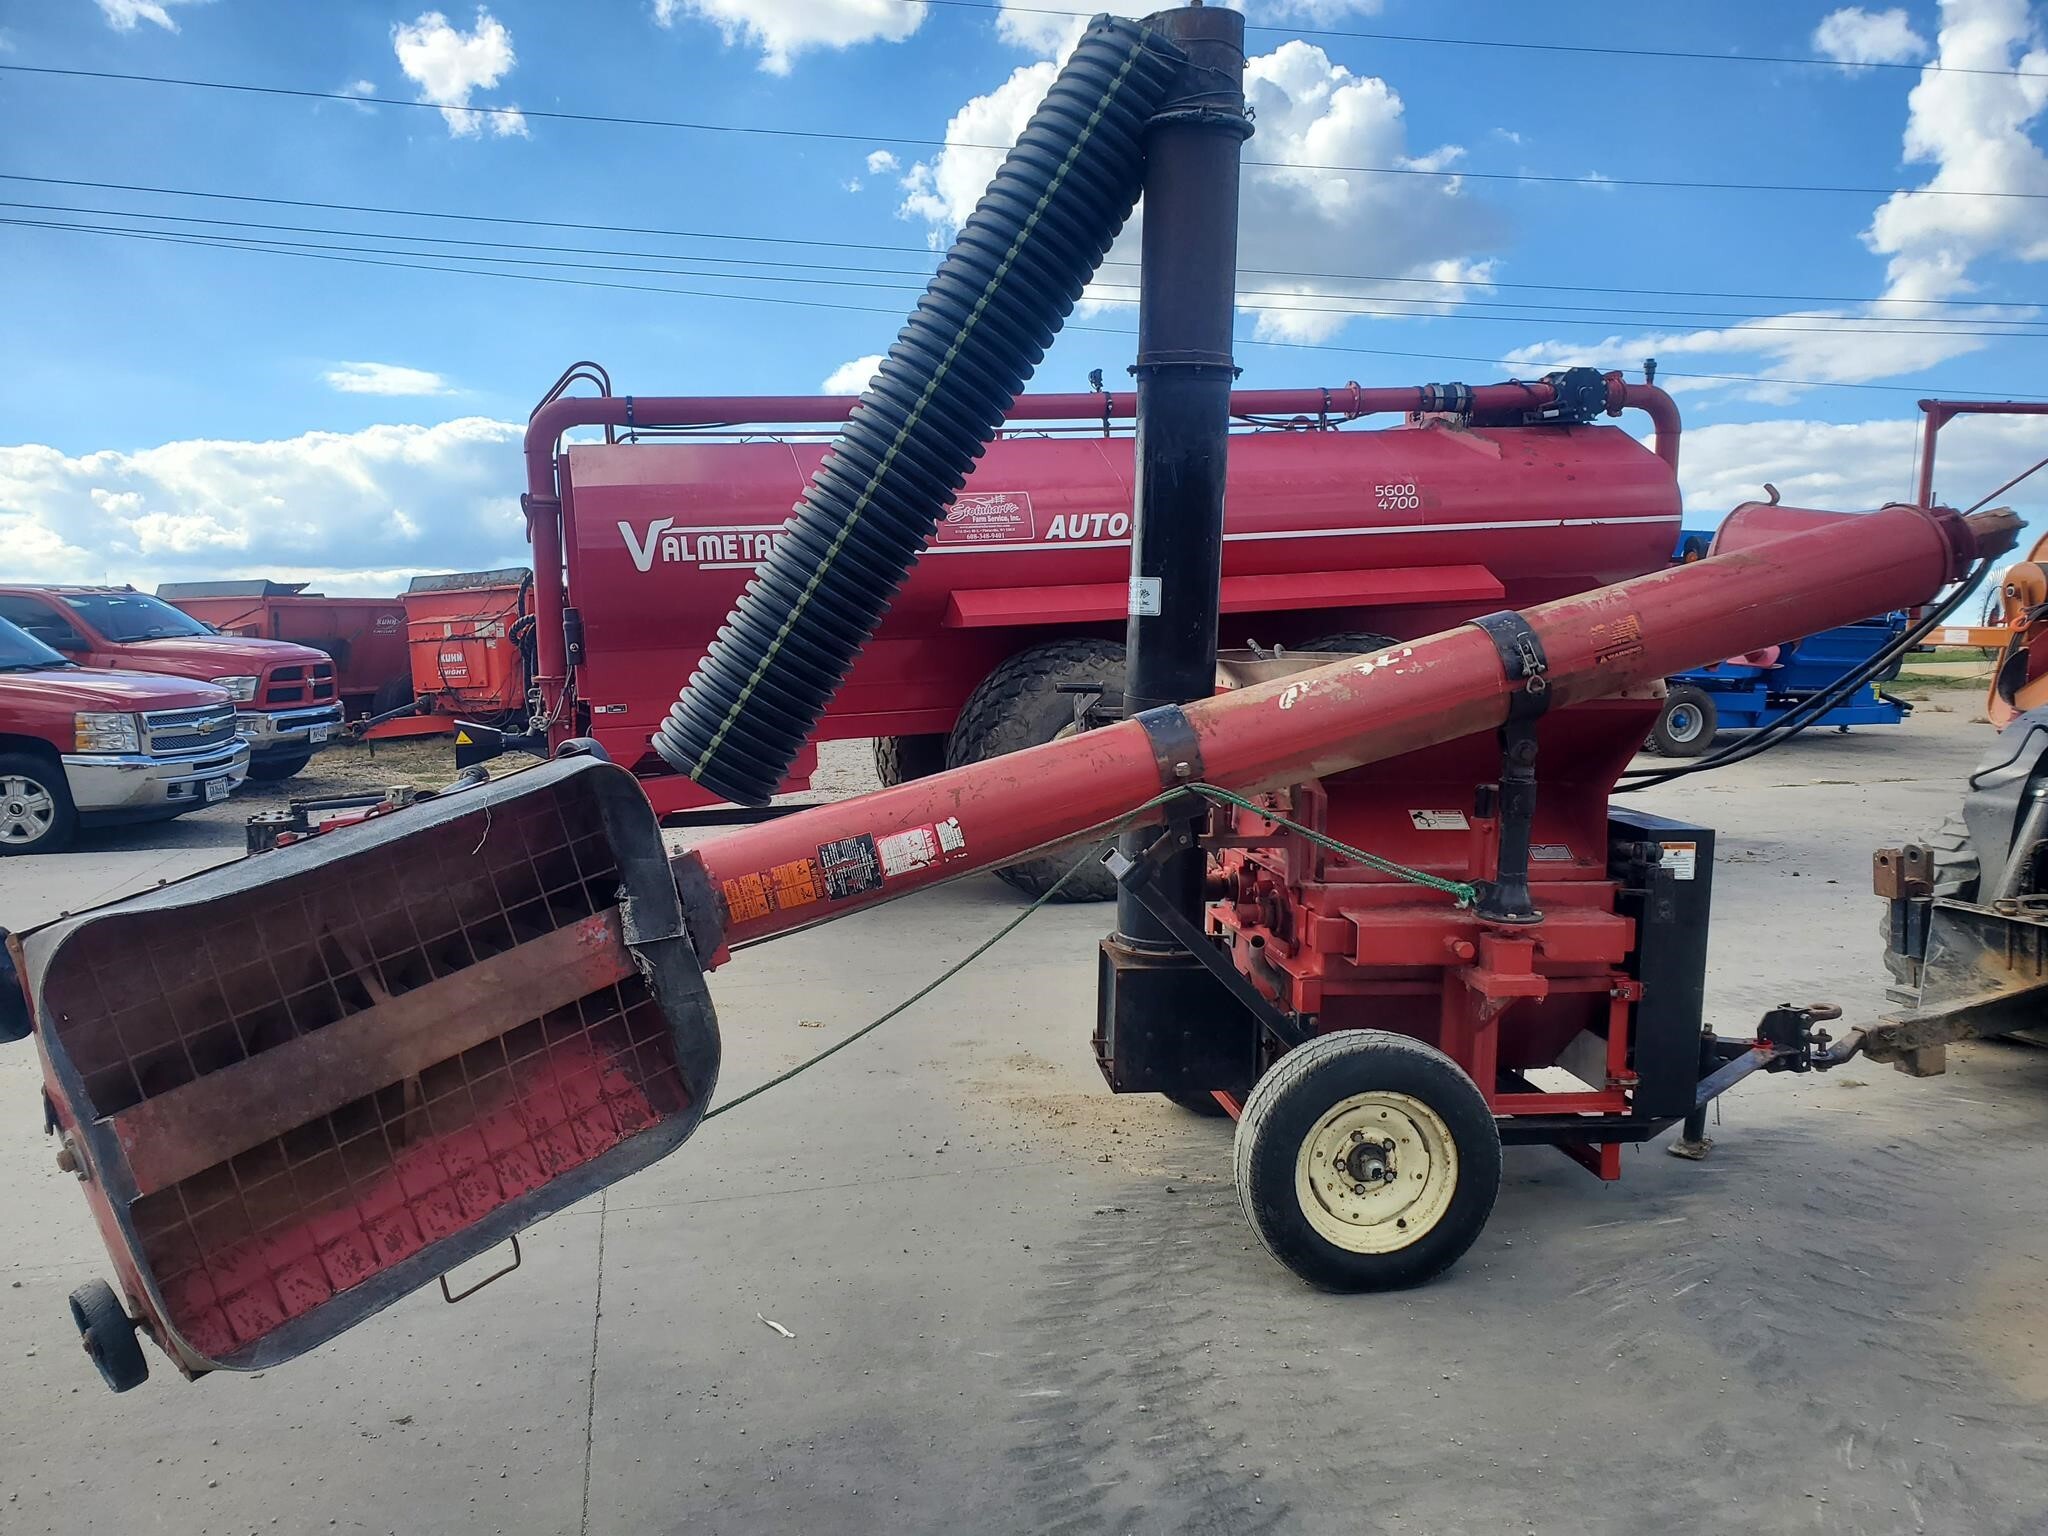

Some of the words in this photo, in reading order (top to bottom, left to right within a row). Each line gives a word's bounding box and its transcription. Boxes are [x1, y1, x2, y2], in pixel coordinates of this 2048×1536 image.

[1375, 484, 1416, 497] 5600
[1377, 496, 1419, 510] 4700
[1044, 512, 1132, 540] AUTO
[440, 653, 463, 663] KUHN
